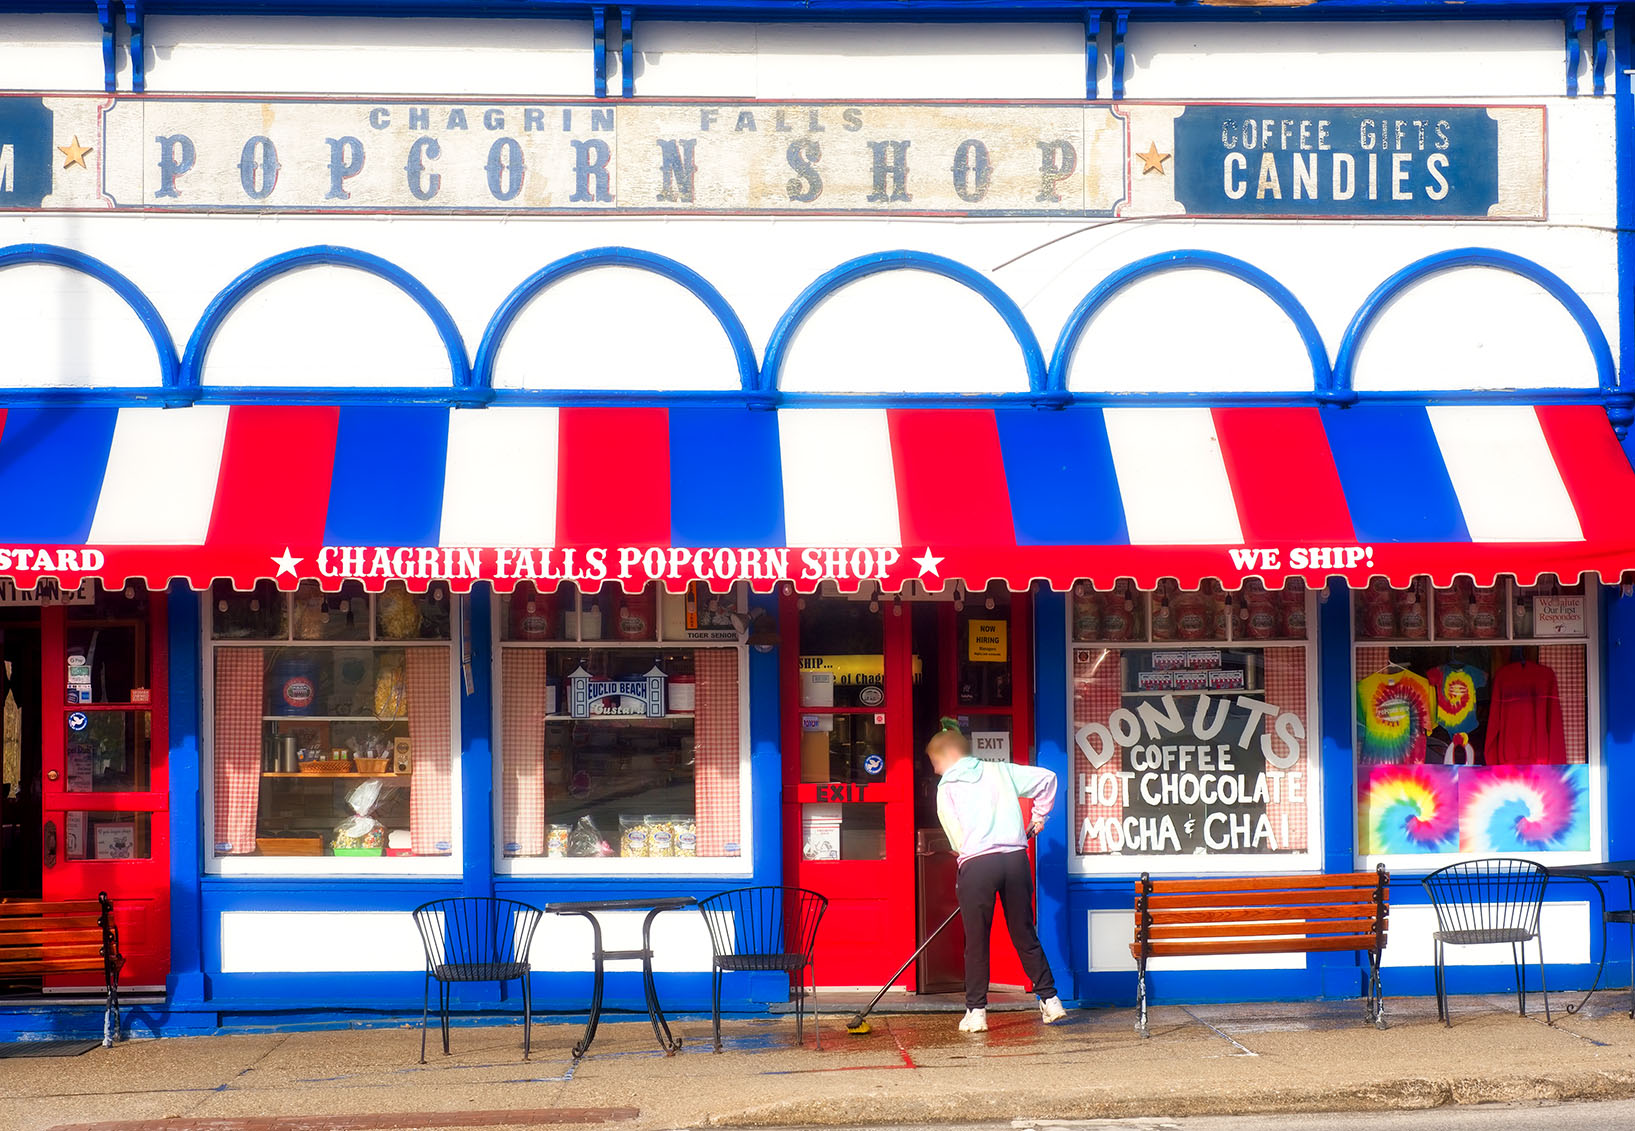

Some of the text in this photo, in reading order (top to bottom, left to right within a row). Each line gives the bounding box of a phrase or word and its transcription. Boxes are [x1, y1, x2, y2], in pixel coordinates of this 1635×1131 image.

[369, 106, 864, 132] CHAGRIN FALLS
[1221, 118, 1451, 151] COFFEE GIFTS
[155, 134, 1078, 203] POPCORN SHOP
[1222, 151, 1451, 201] CANDIES
[316, 546, 900, 581] CHAGRIN FALLS POPCORN SHOP
[1229, 546, 1374, 570] WE SHIP!
[980, 625, 996, 633] NOW
[1539, 613, 1582, 623] Responders
[976, 636, 1000, 644] HIRING
[588, 682, 647, 700] EUCLID BEACH
[976, 737, 1005, 750] EXIT
[1075, 693, 1306, 770] DONUTS
[1130, 744, 1236, 772] COFFEE
[816, 783, 869, 802] EXIT
[1079, 771, 1306, 808] HOT CHOCOLATE
[1078, 814, 1183, 855] MOCHA
[1203, 811, 1290, 852] CHAI
